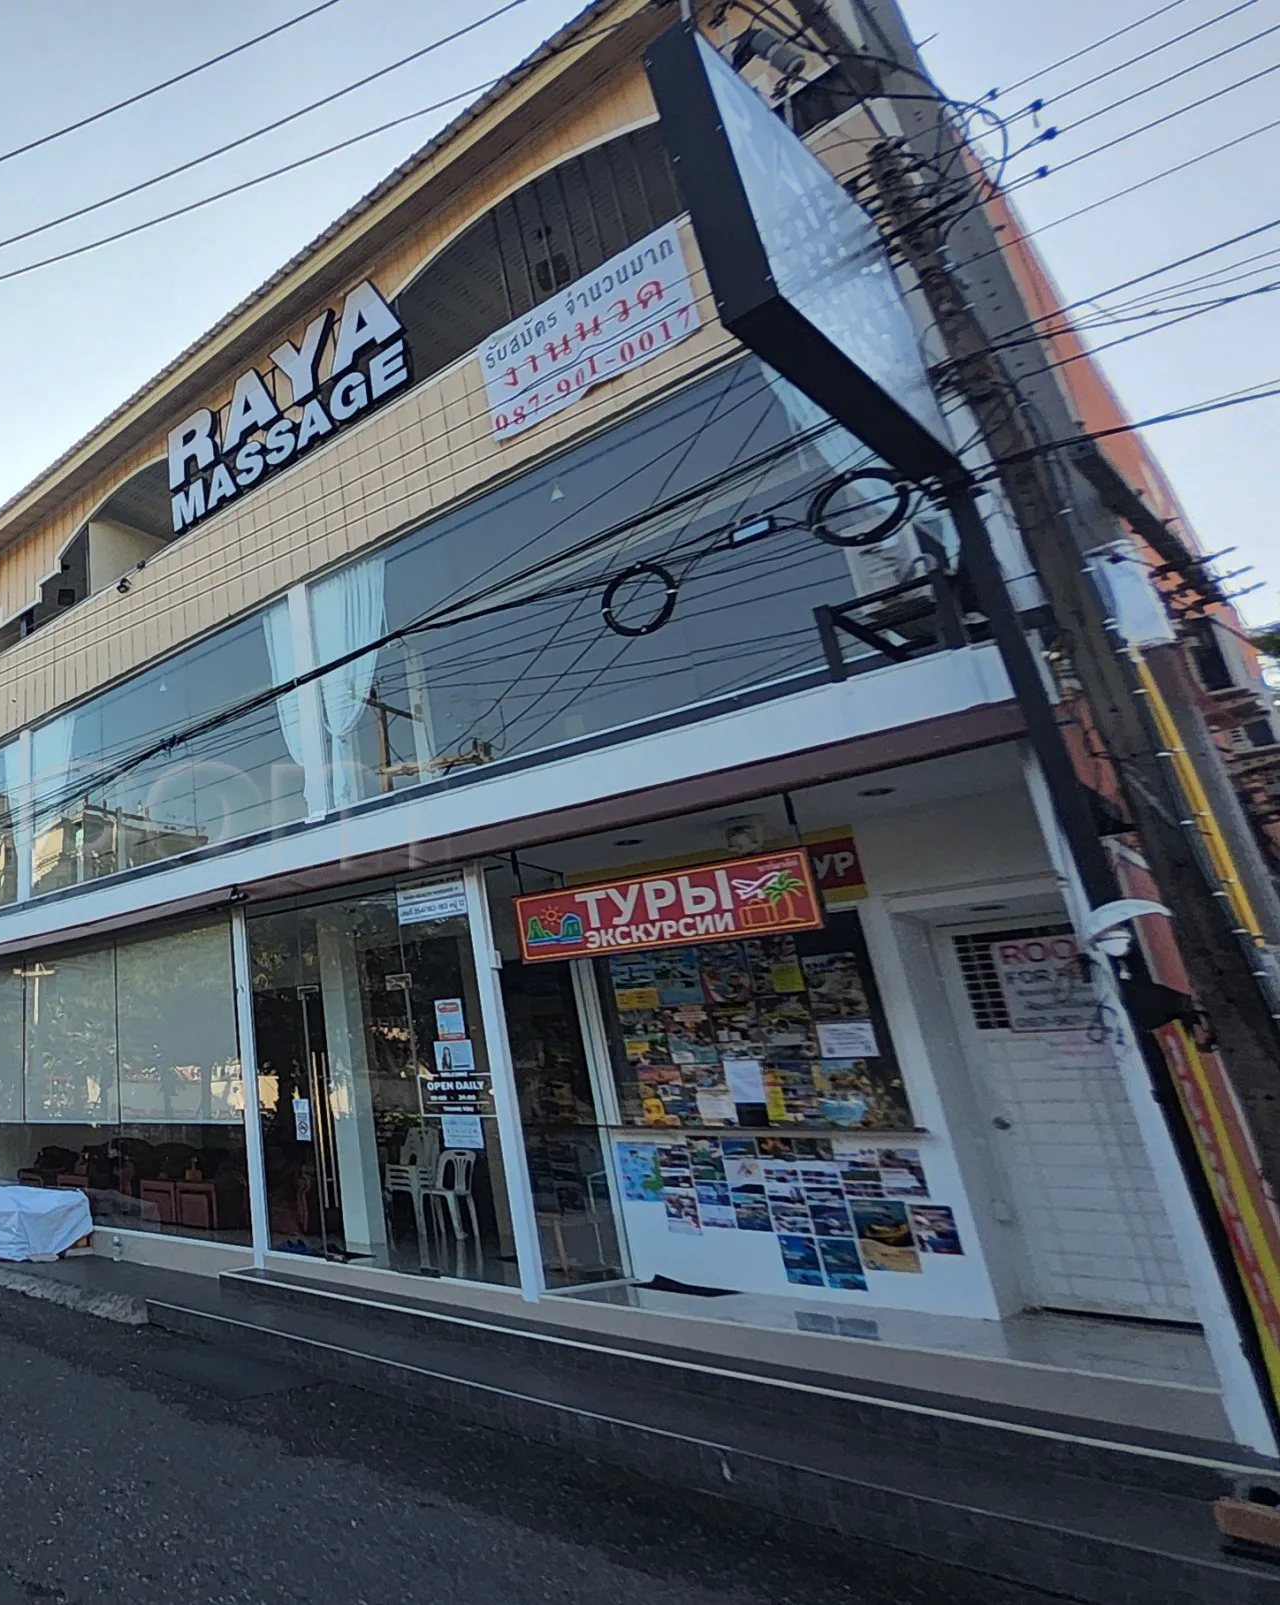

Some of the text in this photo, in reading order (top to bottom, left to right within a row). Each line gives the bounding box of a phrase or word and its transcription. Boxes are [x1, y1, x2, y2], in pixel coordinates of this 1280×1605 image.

[485, 312, 558, 370] รับสมัคร
[495, 304, 692, 431] 087-901-0017
[167, 280, 406, 491] RAYA
[171, 338, 410, 533] MASSAGE
[575, 869, 734, 929] ТУРЫ
[584, 911, 736, 950] ЭКСКУРСИИ
[1000, 939, 1080, 965] ROO
[426, 1080, 485, 1091] OPEN DAILY
